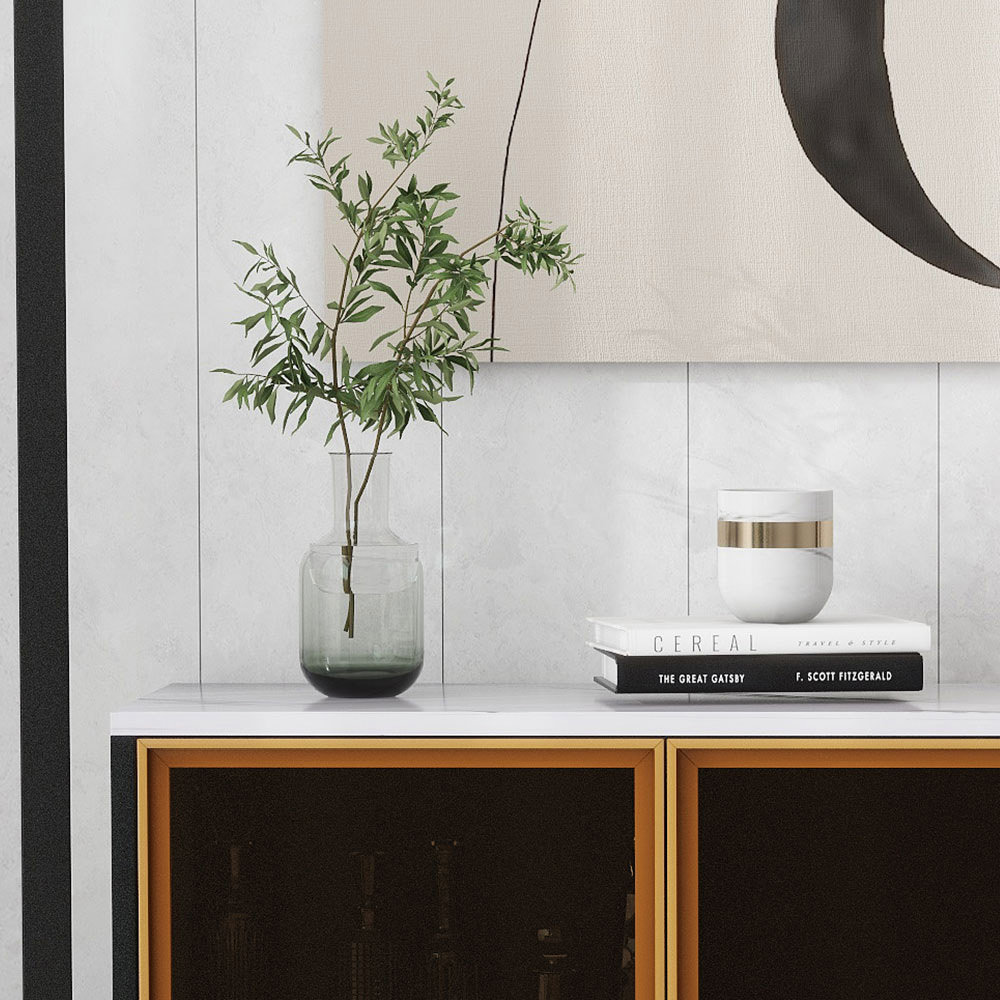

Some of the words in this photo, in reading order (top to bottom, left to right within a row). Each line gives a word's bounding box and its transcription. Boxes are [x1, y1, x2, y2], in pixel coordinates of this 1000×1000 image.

[653, 634, 758, 653] CEREAL
[658, 674, 676, 684] THE
[678, 673, 708, 684] GREAT
[711, 673, 745, 684] GATSBY
[796, 671, 804, 682] F.
[807, 671, 836, 682] SCOTT
[838, 671, 893, 681] FITZGERALD
